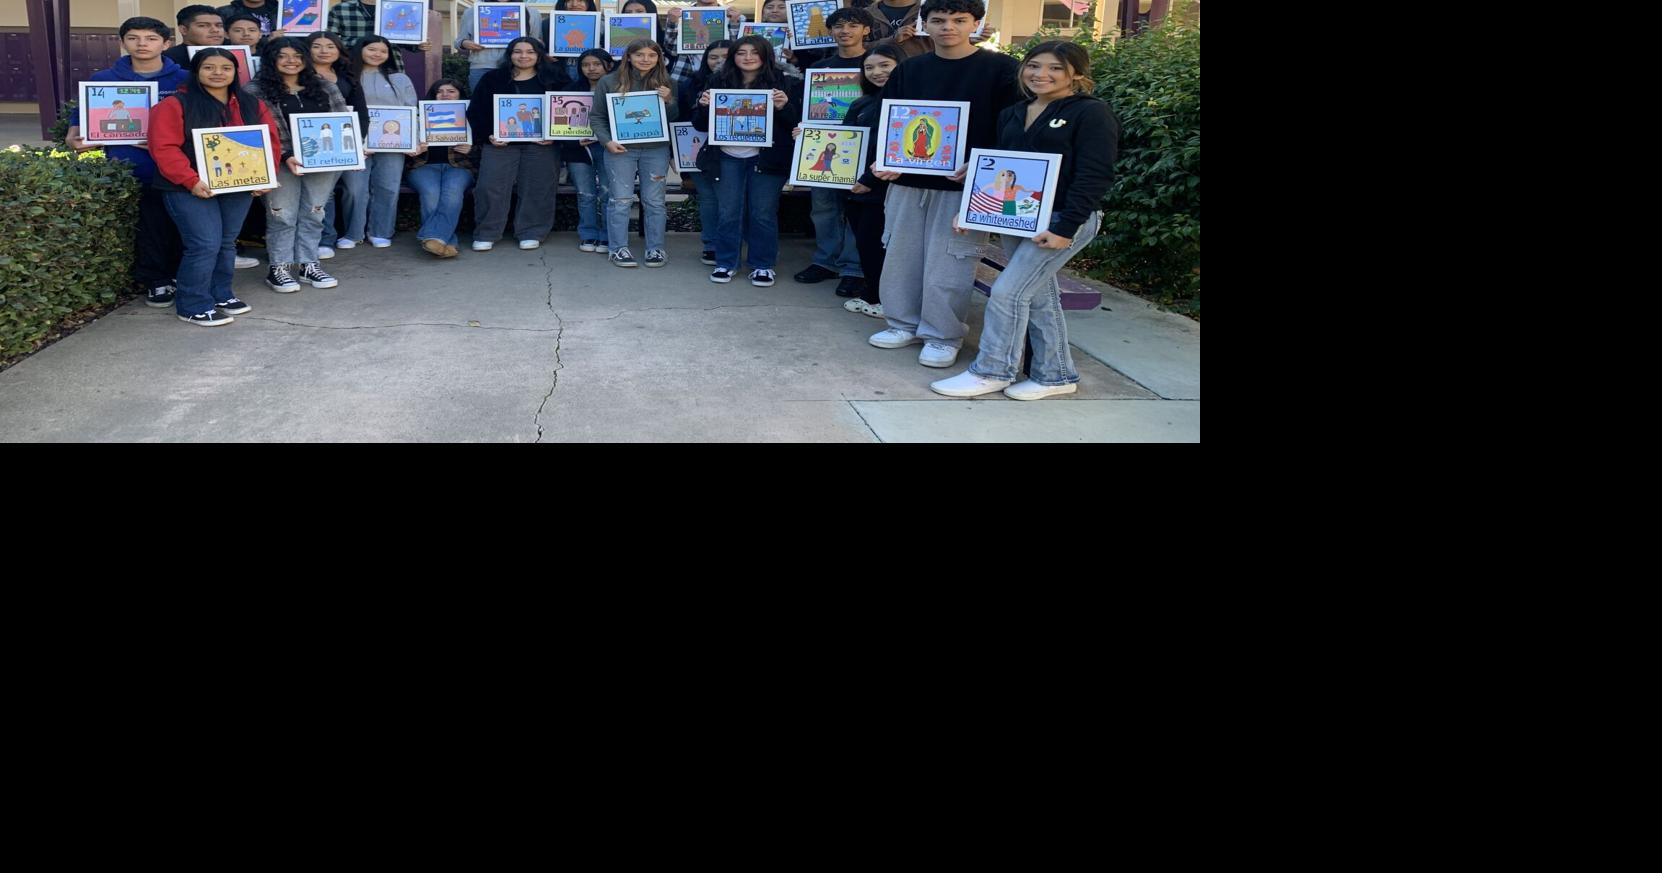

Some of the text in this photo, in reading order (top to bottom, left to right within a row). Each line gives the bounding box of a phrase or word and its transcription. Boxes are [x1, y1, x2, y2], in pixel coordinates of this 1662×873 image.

[480, 6, 491, 15] 15
[558, 15, 566, 24] 8
[685, 12, 693, 20] 1
[610, 17, 622, 27] 22
[813, 74, 826, 83] 21
[91, 87, 105, 99] 14
[501, 98, 513, 108] 18
[553, 97, 564, 105] 15
[613, 98, 626, 107] 17
[718, 94, 728, 105] 9
[370, 110, 381, 118] 16
[810, 111, 818, 119] La
[891, 106, 911, 119] 12
[302, 119, 314, 128] 11
[634, 129, 661, 140] papá
[677, 128, 689, 137] 28
[805, 128, 821, 141] 23
[308, 156, 354, 167] El reflejo
[888, 156, 951, 168] La virgen
[980, 157, 996, 171] 2
[211, 174, 267, 188] Las metas
[799, 172, 808, 180] La
[968, 212, 1036, 230] La whitewashed
